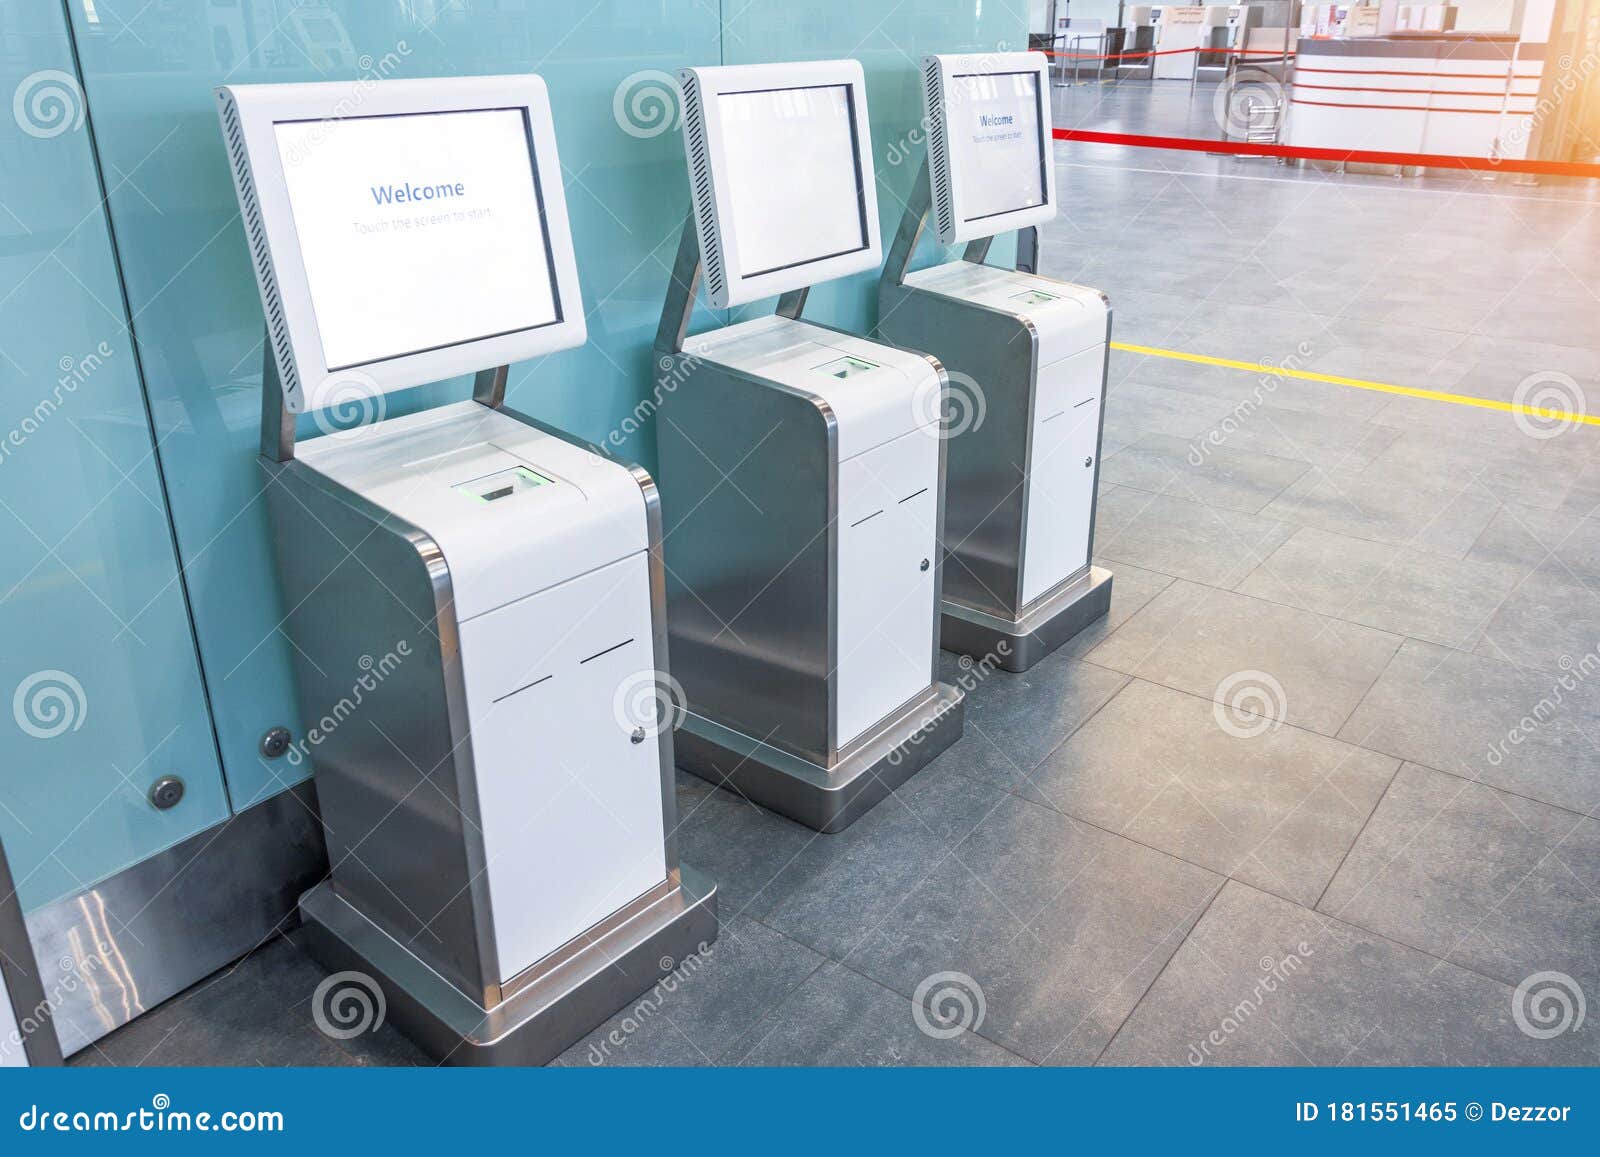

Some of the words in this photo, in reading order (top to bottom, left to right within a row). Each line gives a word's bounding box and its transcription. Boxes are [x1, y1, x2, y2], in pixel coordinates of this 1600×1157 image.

[978, 114, 1013, 127] Welcome
[370, 182, 465, 205] Welcome
[353, 218, 389, 235] Touch
[391, 215, 412, 231] the
[414, 213, 450, 227] screen
[452, 211, 465, 222] to
[467, 207, 492, 221] start
